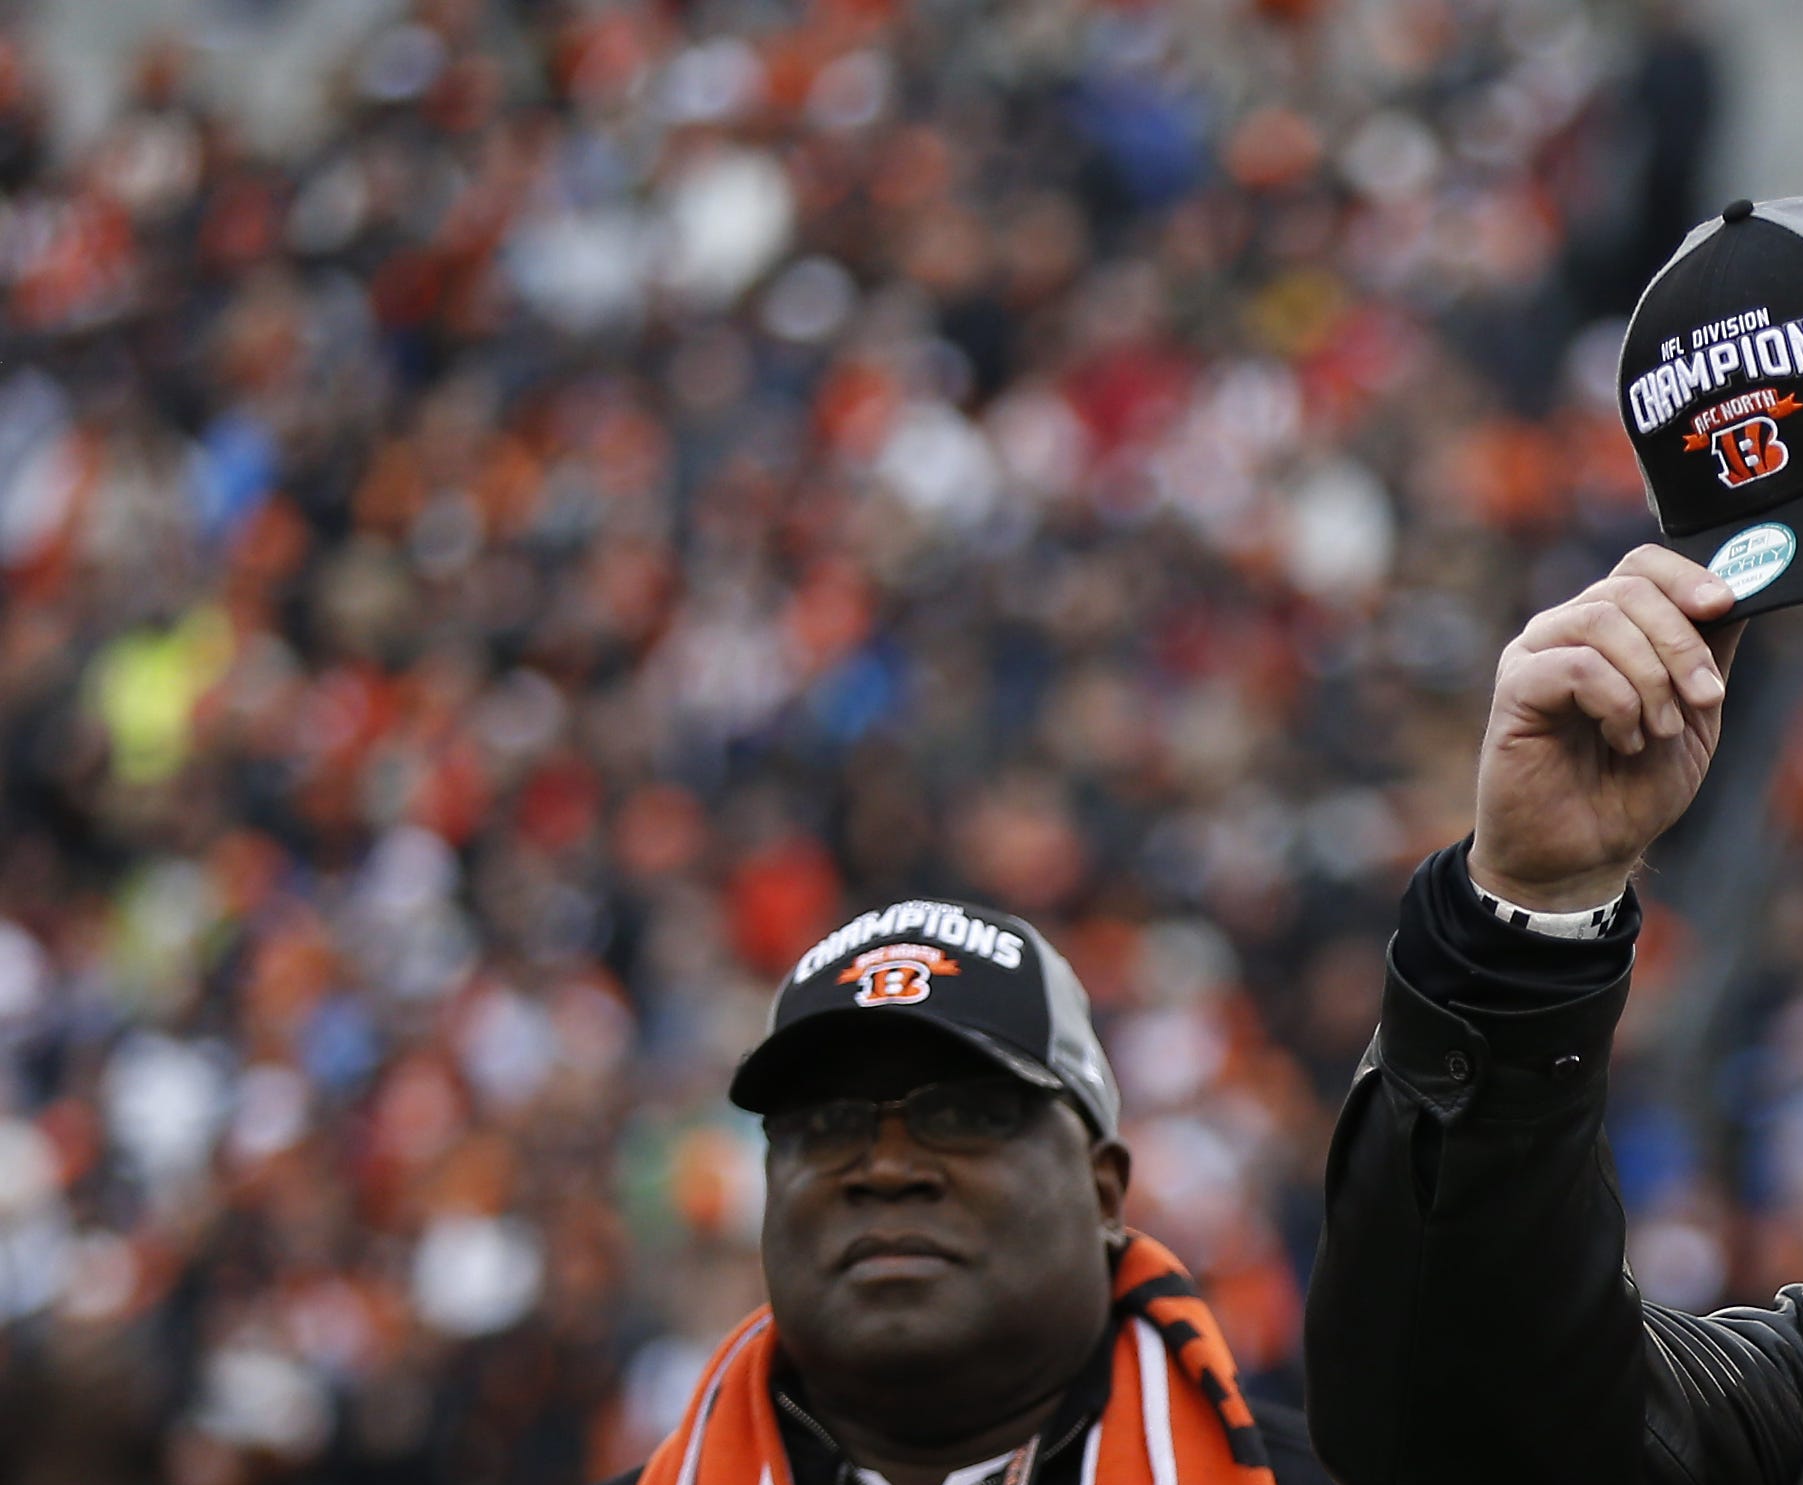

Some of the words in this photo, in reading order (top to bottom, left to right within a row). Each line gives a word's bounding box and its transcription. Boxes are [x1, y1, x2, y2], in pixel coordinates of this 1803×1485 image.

[1661, 336, 1685, 362] NFL
[1692, 307, 1771, 348] DIVISION
[1694, 412, 1723, 435] AFC
[1722, 390, 1777, 421] NORTH
[793, 900, 1025, 970] CHAMPIONS
